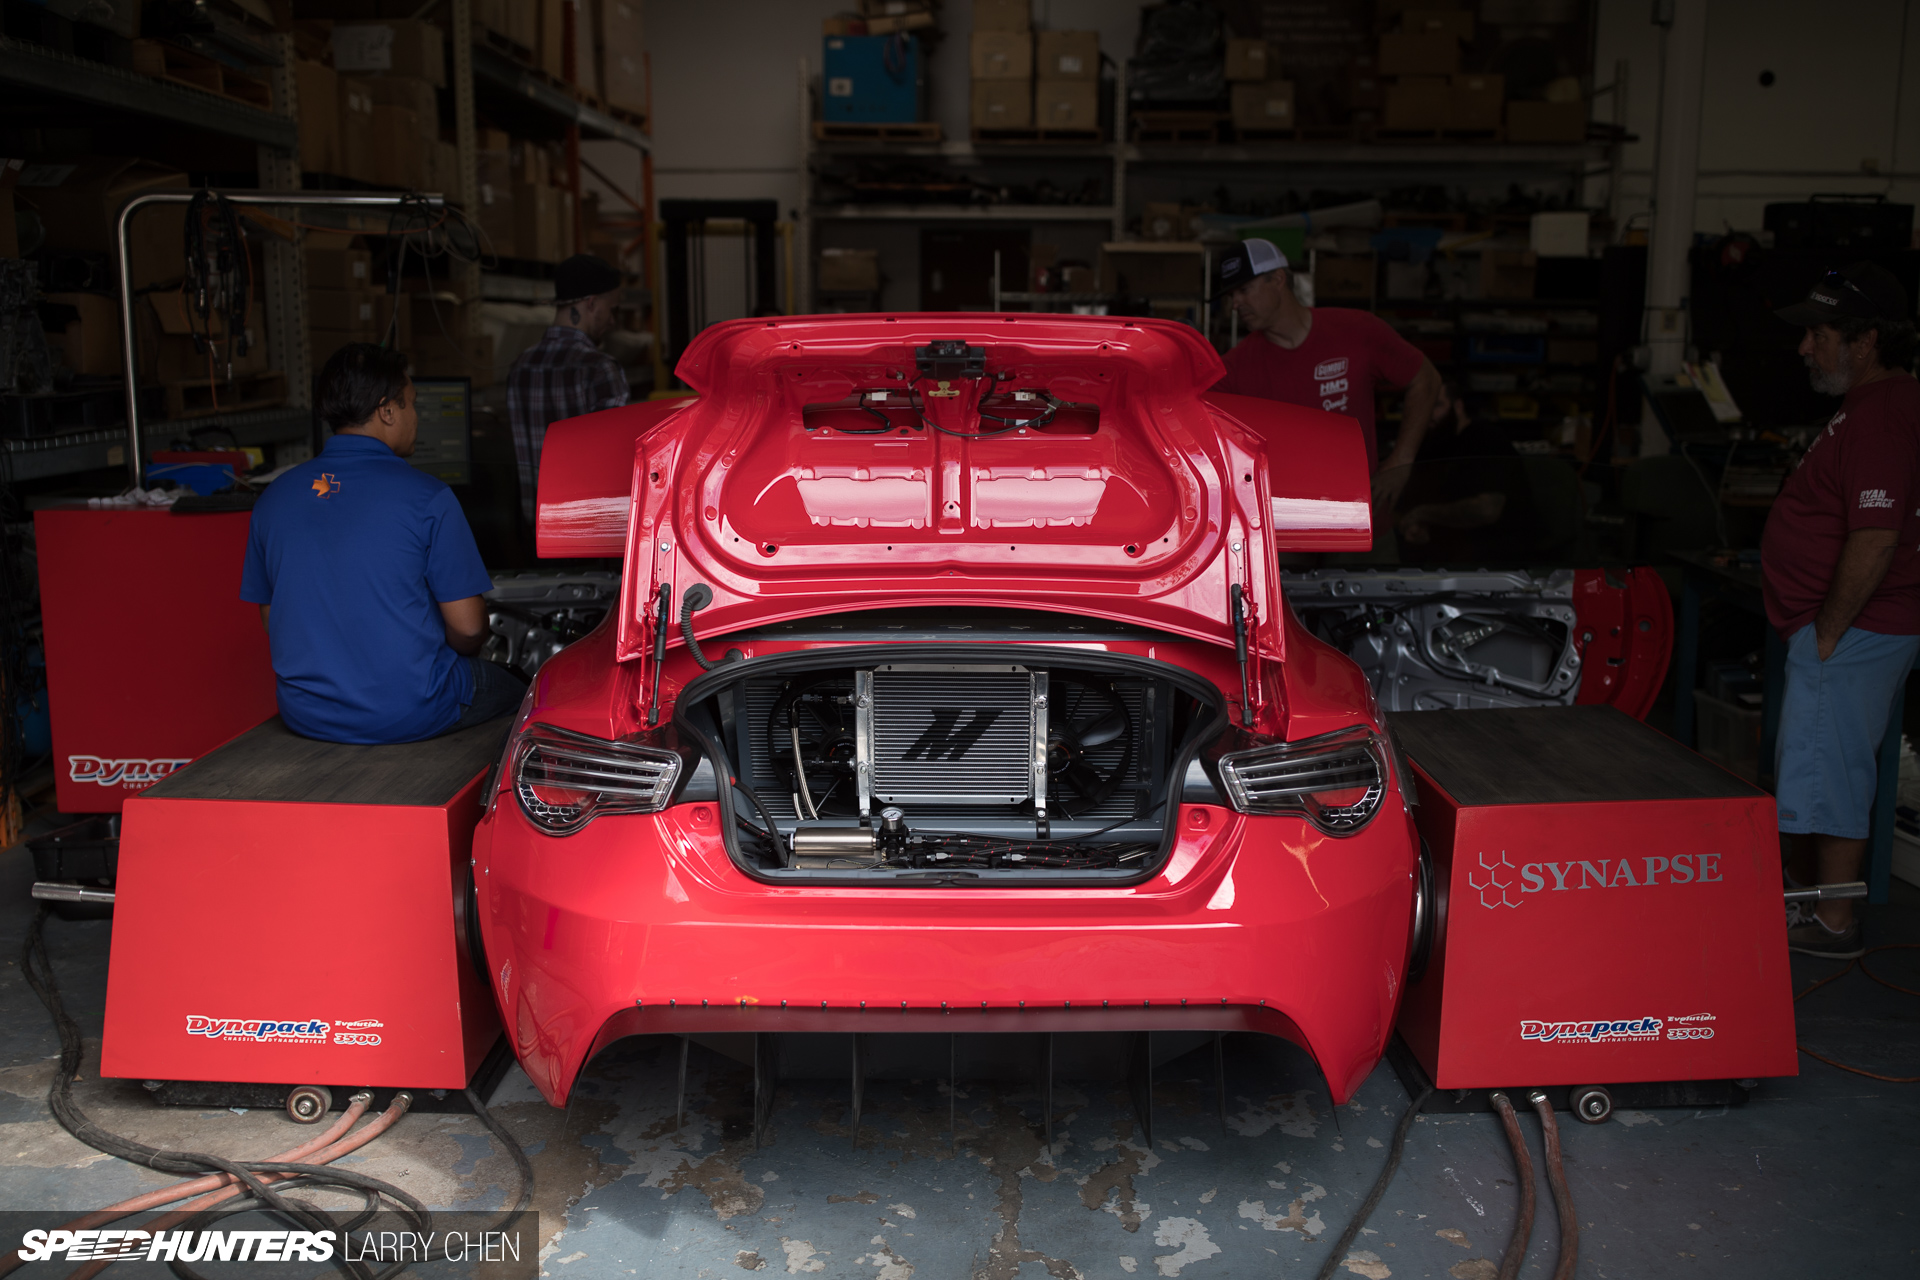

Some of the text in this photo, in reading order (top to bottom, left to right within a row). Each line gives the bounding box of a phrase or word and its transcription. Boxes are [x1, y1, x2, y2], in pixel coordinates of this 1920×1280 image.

[1859, 489, 1887, 500] RYAN
[1521, 853, 1723, 893] SYNAPSE
[186, 1015, 384, 1042] Dynapack Evolution
[1520, 1014, 1717, 1042] Dynapack Evolution
[1667, 1028, 1714, 1040] 3500
[333, 1033, 381, 1046] 3500
